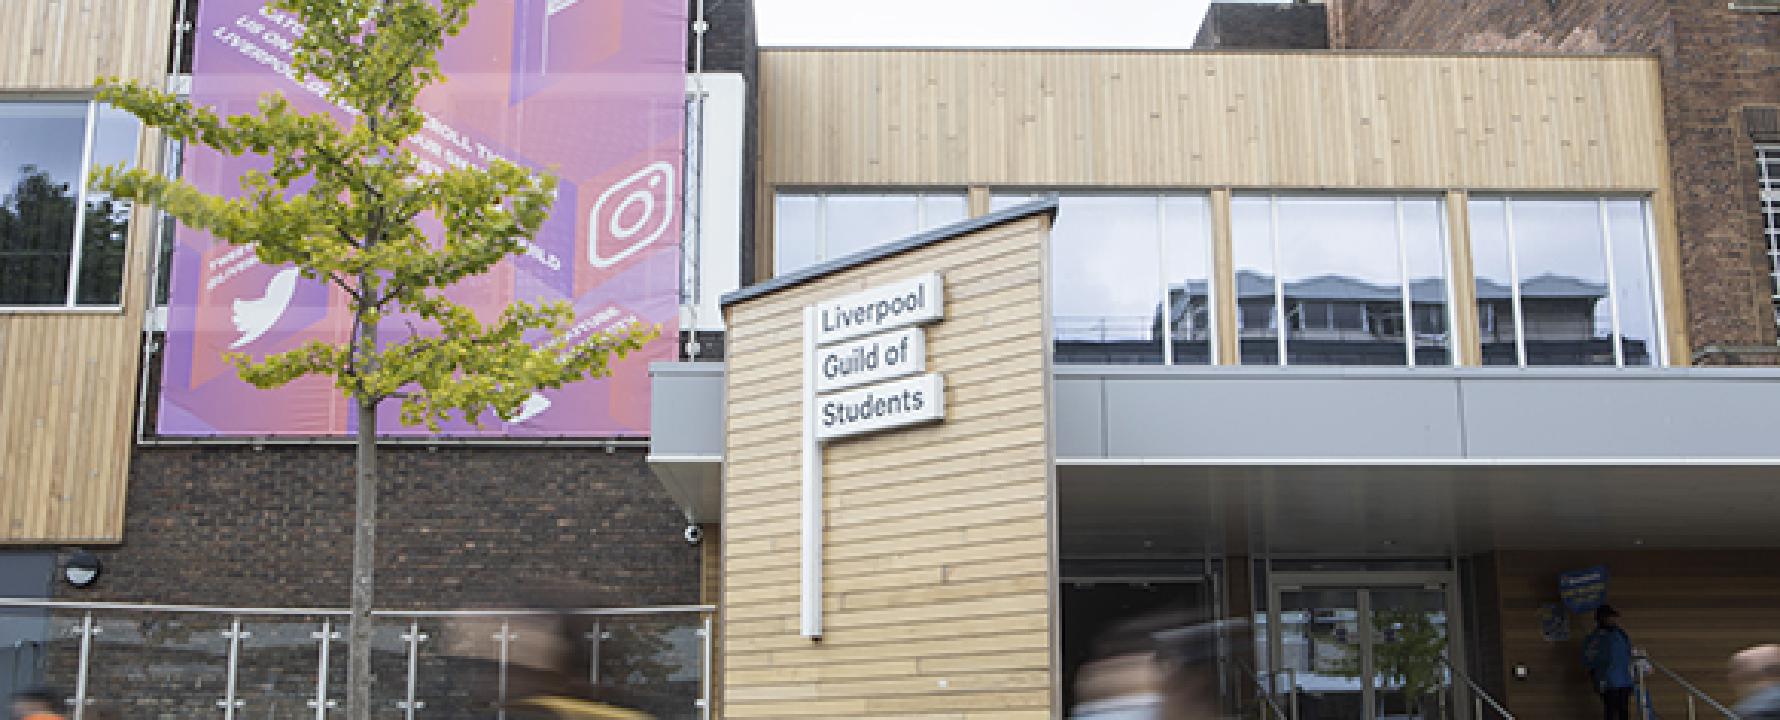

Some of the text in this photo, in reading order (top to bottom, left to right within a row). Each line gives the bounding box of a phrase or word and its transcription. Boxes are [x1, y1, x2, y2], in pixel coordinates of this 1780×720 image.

[821, 282, 926, 333] Liverpool
[822, 336, 910, 380] Guild of
[821, 389, 925, 428] Students
